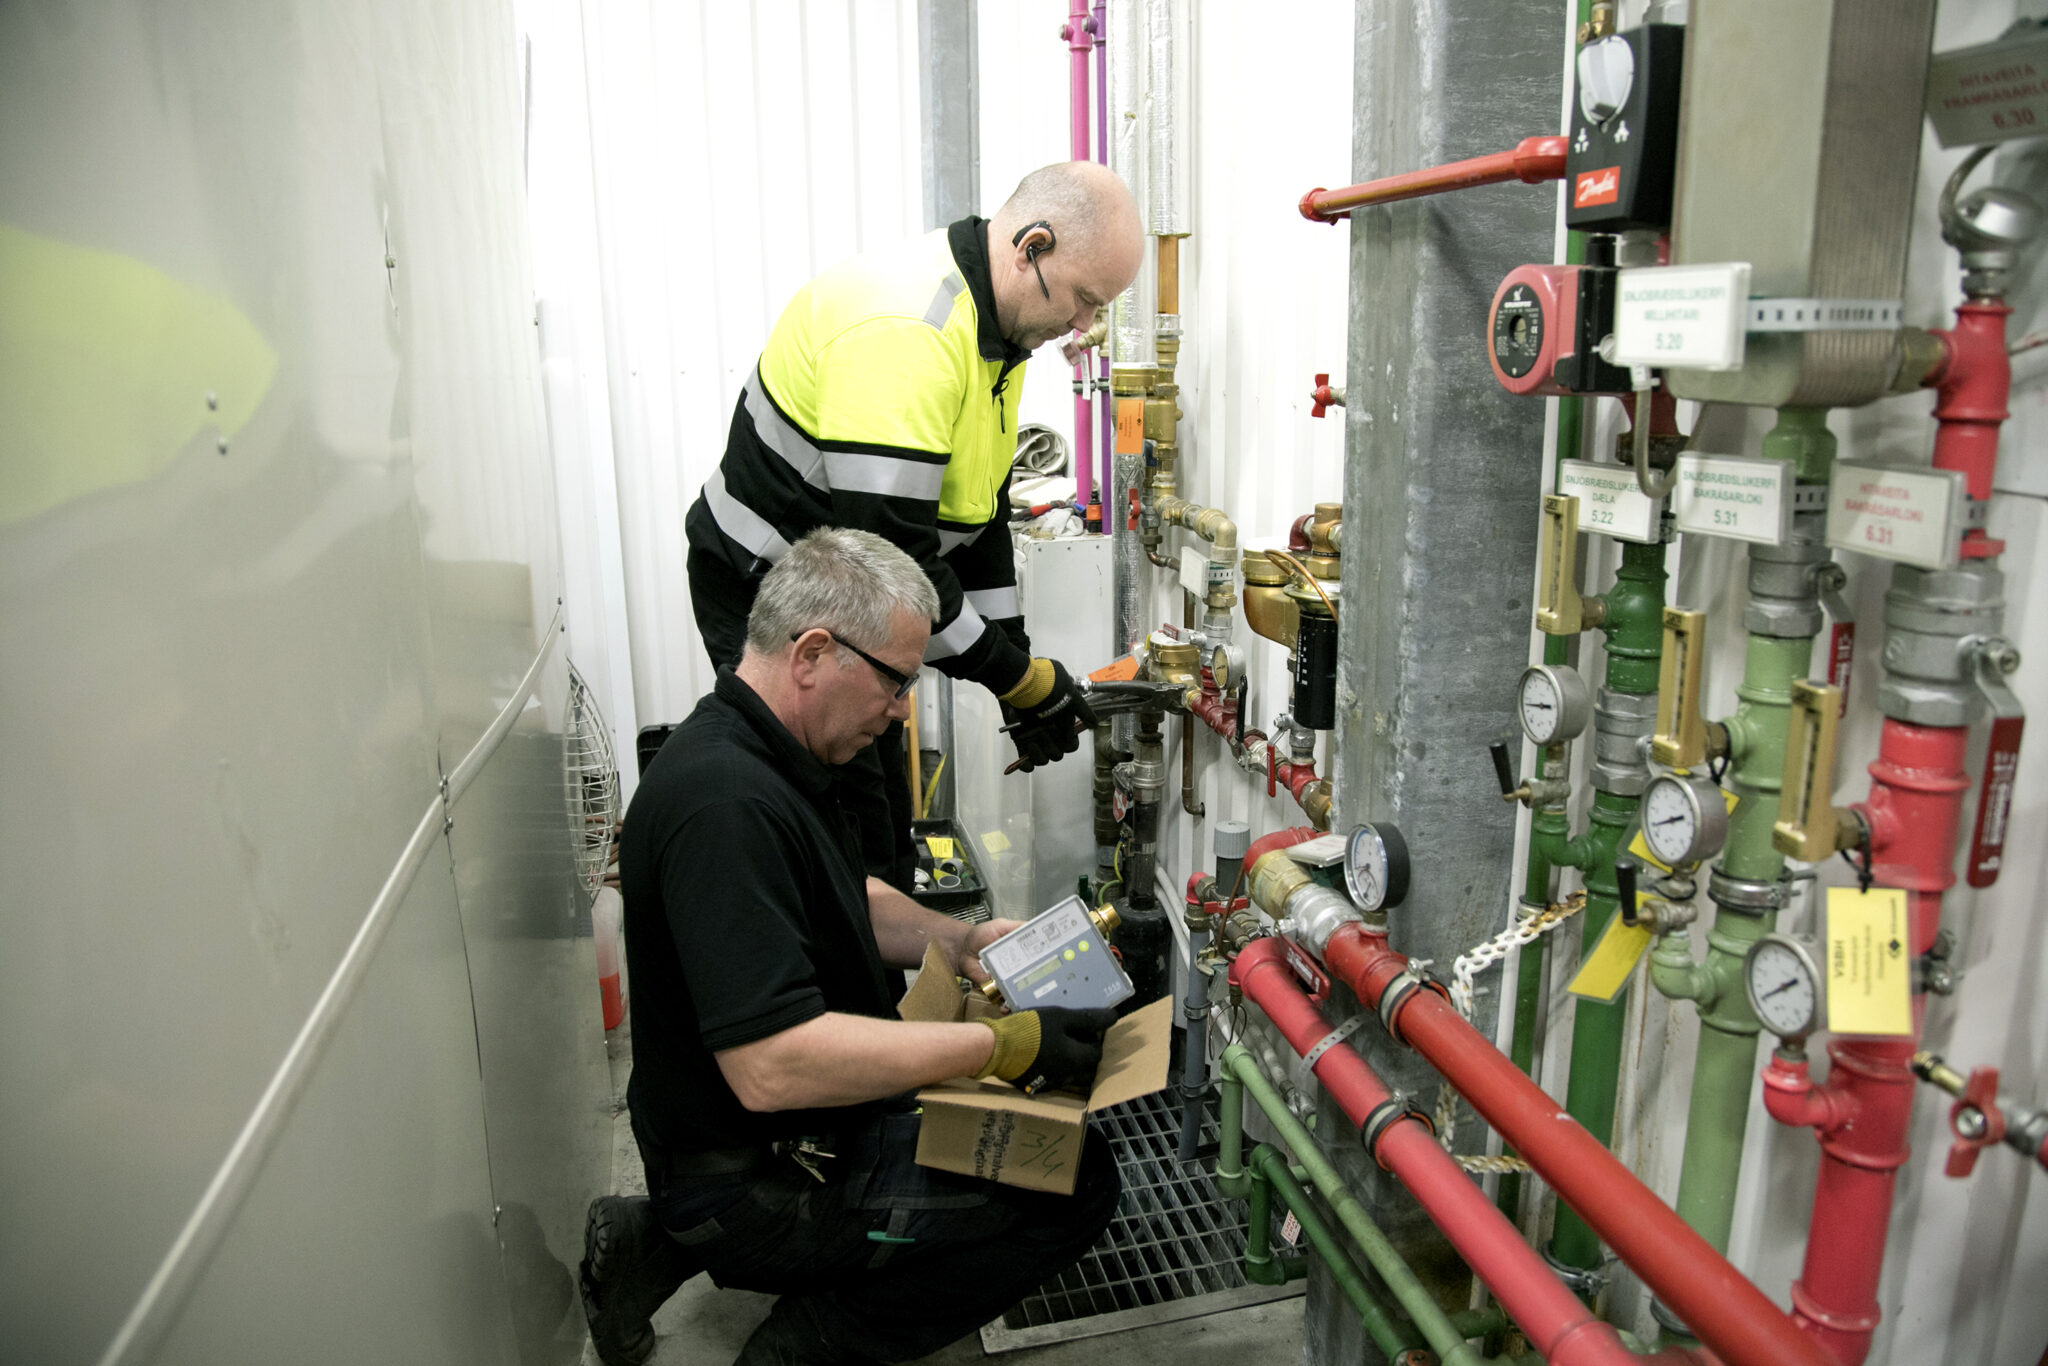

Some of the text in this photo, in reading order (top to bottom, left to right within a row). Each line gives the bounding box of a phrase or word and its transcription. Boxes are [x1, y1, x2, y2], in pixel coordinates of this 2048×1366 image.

[1992, 106, 2035, 129] 6.30
[1655, 332, 1683, 350] 5.20
[1592, 509, 1614, 525] 5.22
[1714, 509, 1738, 526] 5.31
[1866, 524, 1893, 545] 6.31
